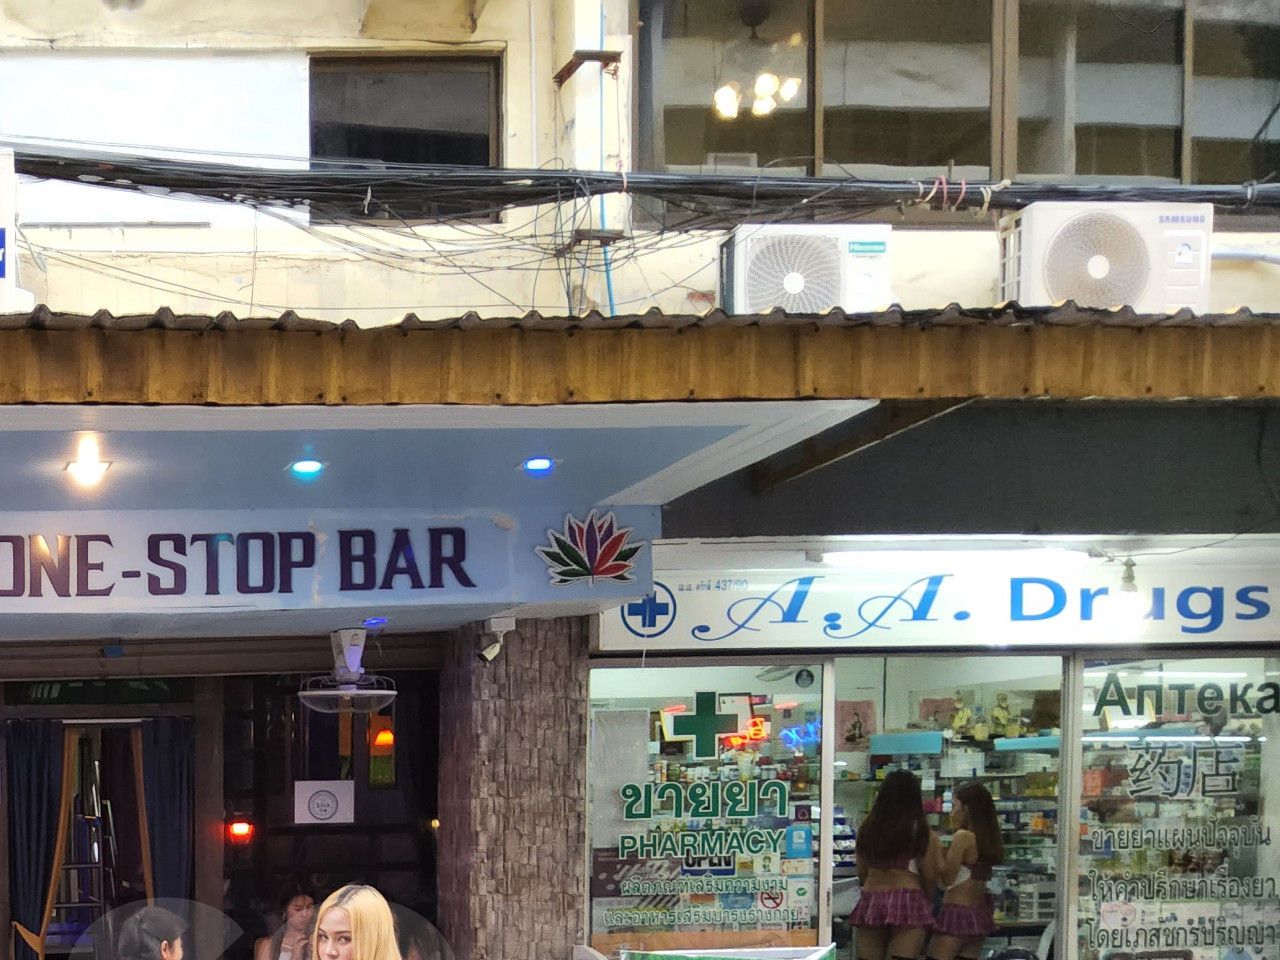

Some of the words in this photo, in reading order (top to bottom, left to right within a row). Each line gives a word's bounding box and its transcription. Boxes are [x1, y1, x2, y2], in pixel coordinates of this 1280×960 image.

[1158, 215, 1206, 223] SAMSUNG
[339, 526, 477, 591] BAR
[1093, 672, 1280, 716] Аптека
[1127, 741, 1245, 798] 药店
[620, 779, 789, 820] ขายยา
[619, 829, 787, 859] PHARMACY
